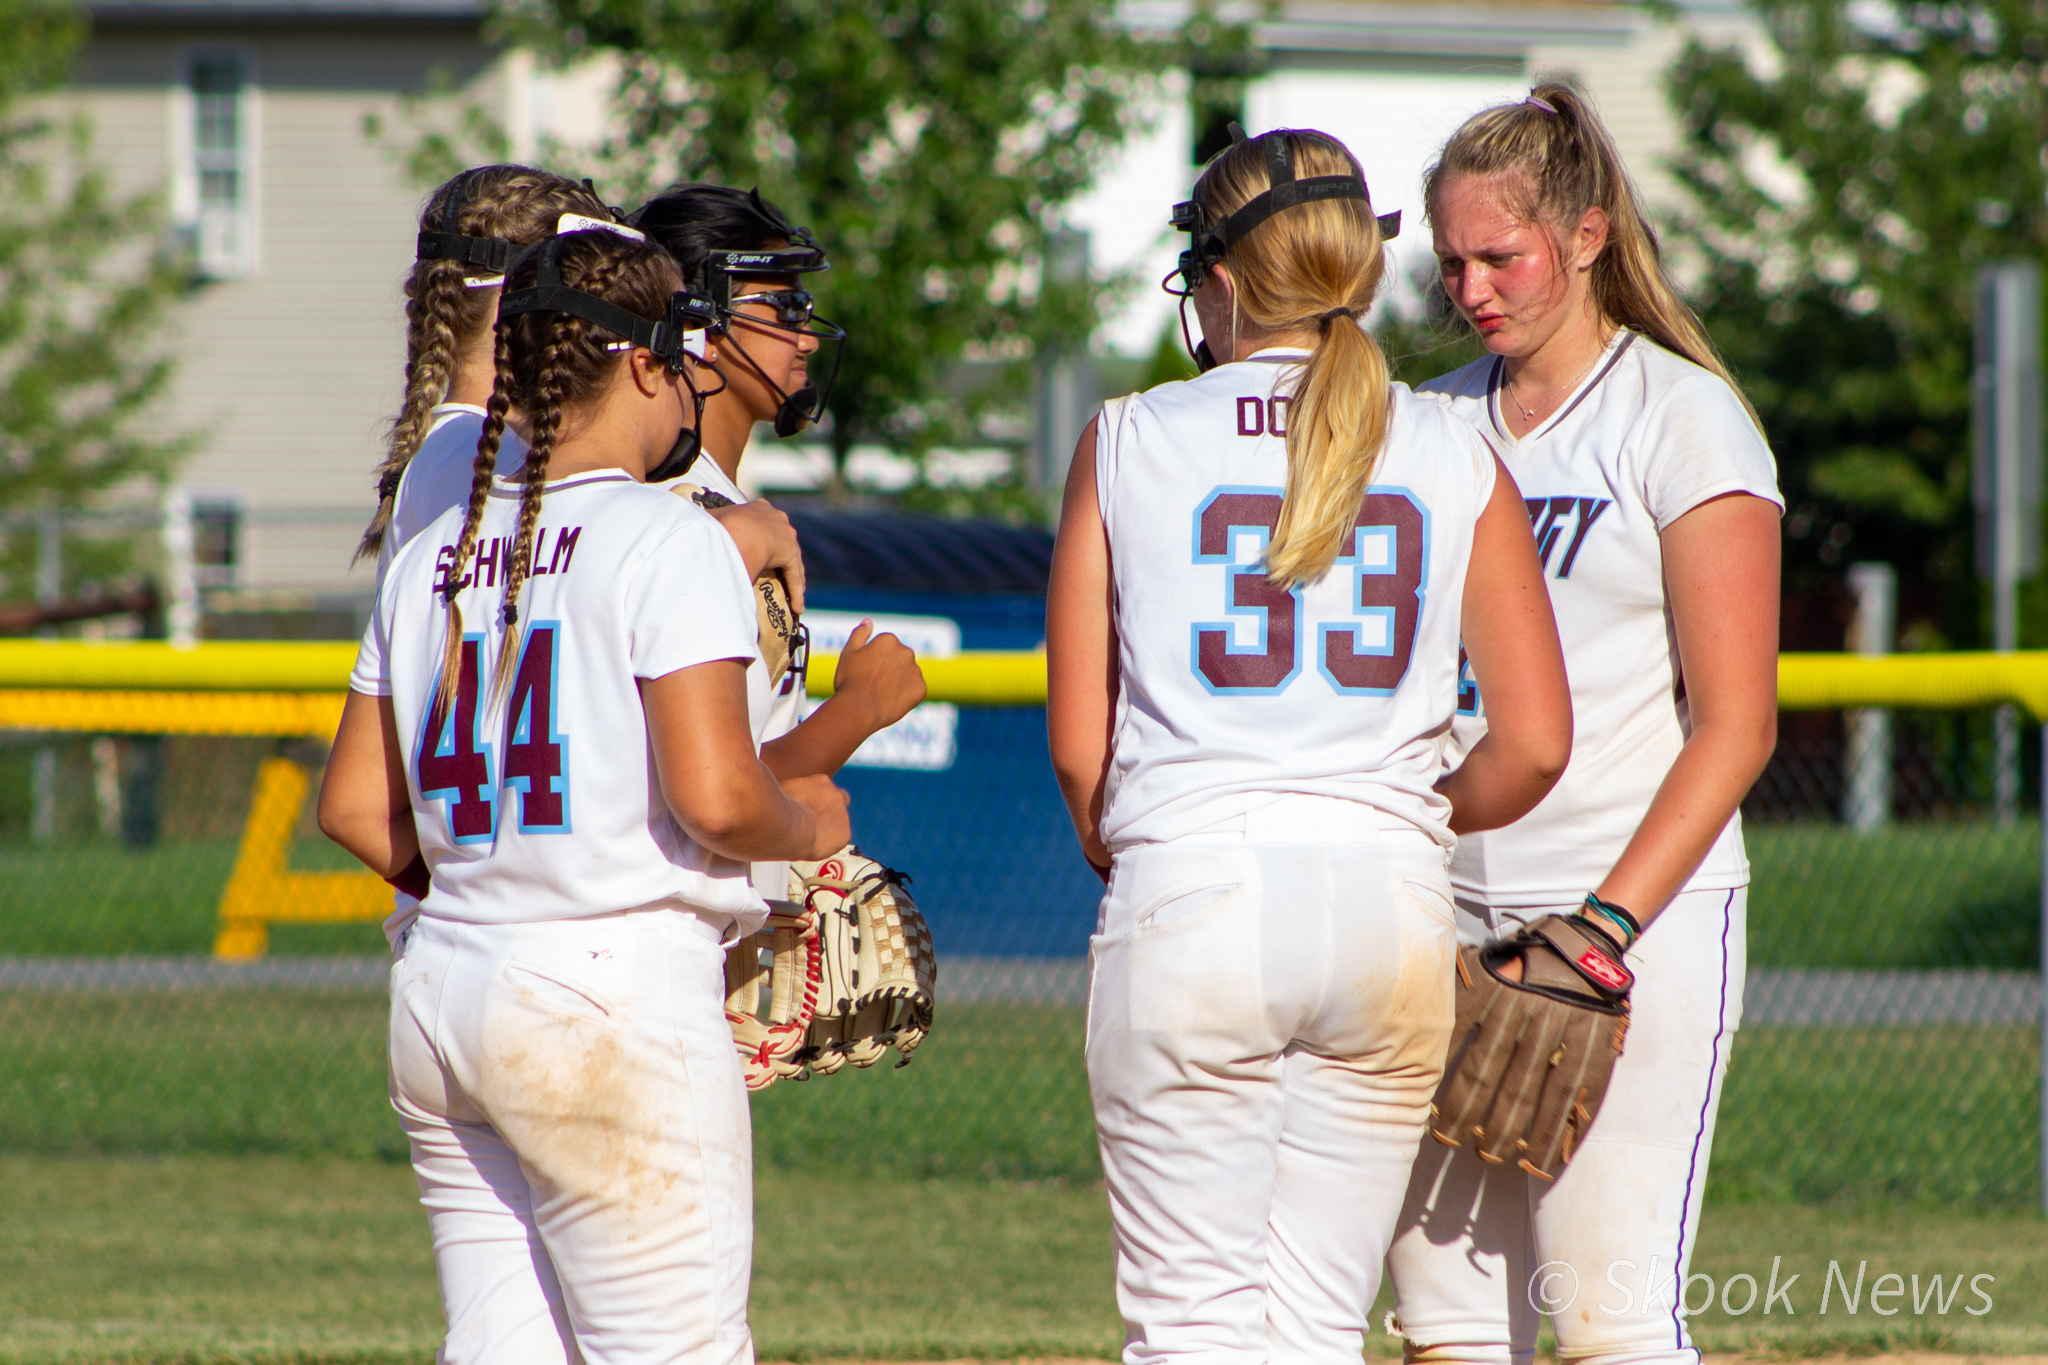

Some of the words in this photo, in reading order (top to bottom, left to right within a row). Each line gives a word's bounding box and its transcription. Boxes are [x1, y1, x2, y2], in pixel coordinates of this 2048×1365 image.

[689, 298, 711, 310] RIP-IT
[739, 254, 774, 264] RIP-IT
[1190, 484, 1432, 698] 33
[416, 619, 573, 846] 44
